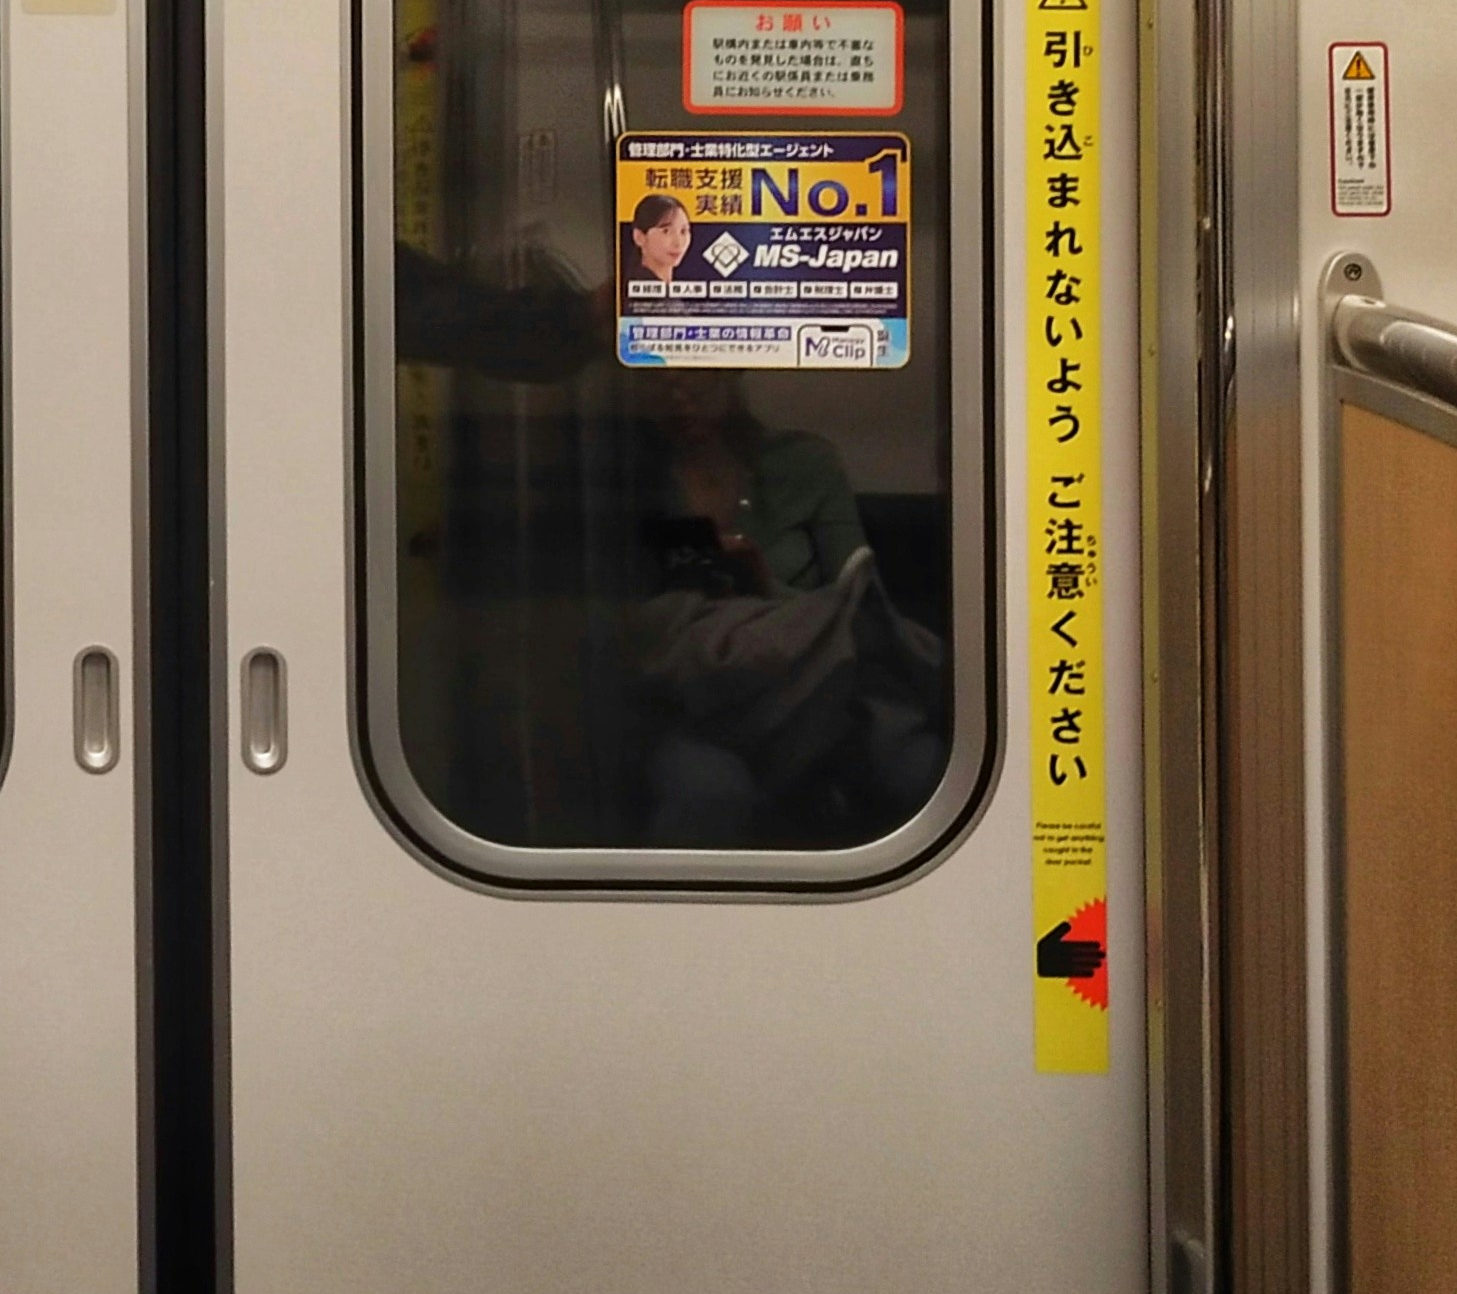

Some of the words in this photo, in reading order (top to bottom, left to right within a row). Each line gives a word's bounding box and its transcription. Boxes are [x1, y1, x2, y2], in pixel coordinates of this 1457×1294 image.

[645, 167, 743, 190] 転職支援
[750, 150, 899, 217] No.1
[695, 194, 743, 216] 実績
[769, 226, 883, 242] エムエスジャパン
[753, 244, 899, 273] MS-Japan
[831, 345, 867, 360] Clip
[1045, 472, 1087, 786] ご注意ください
